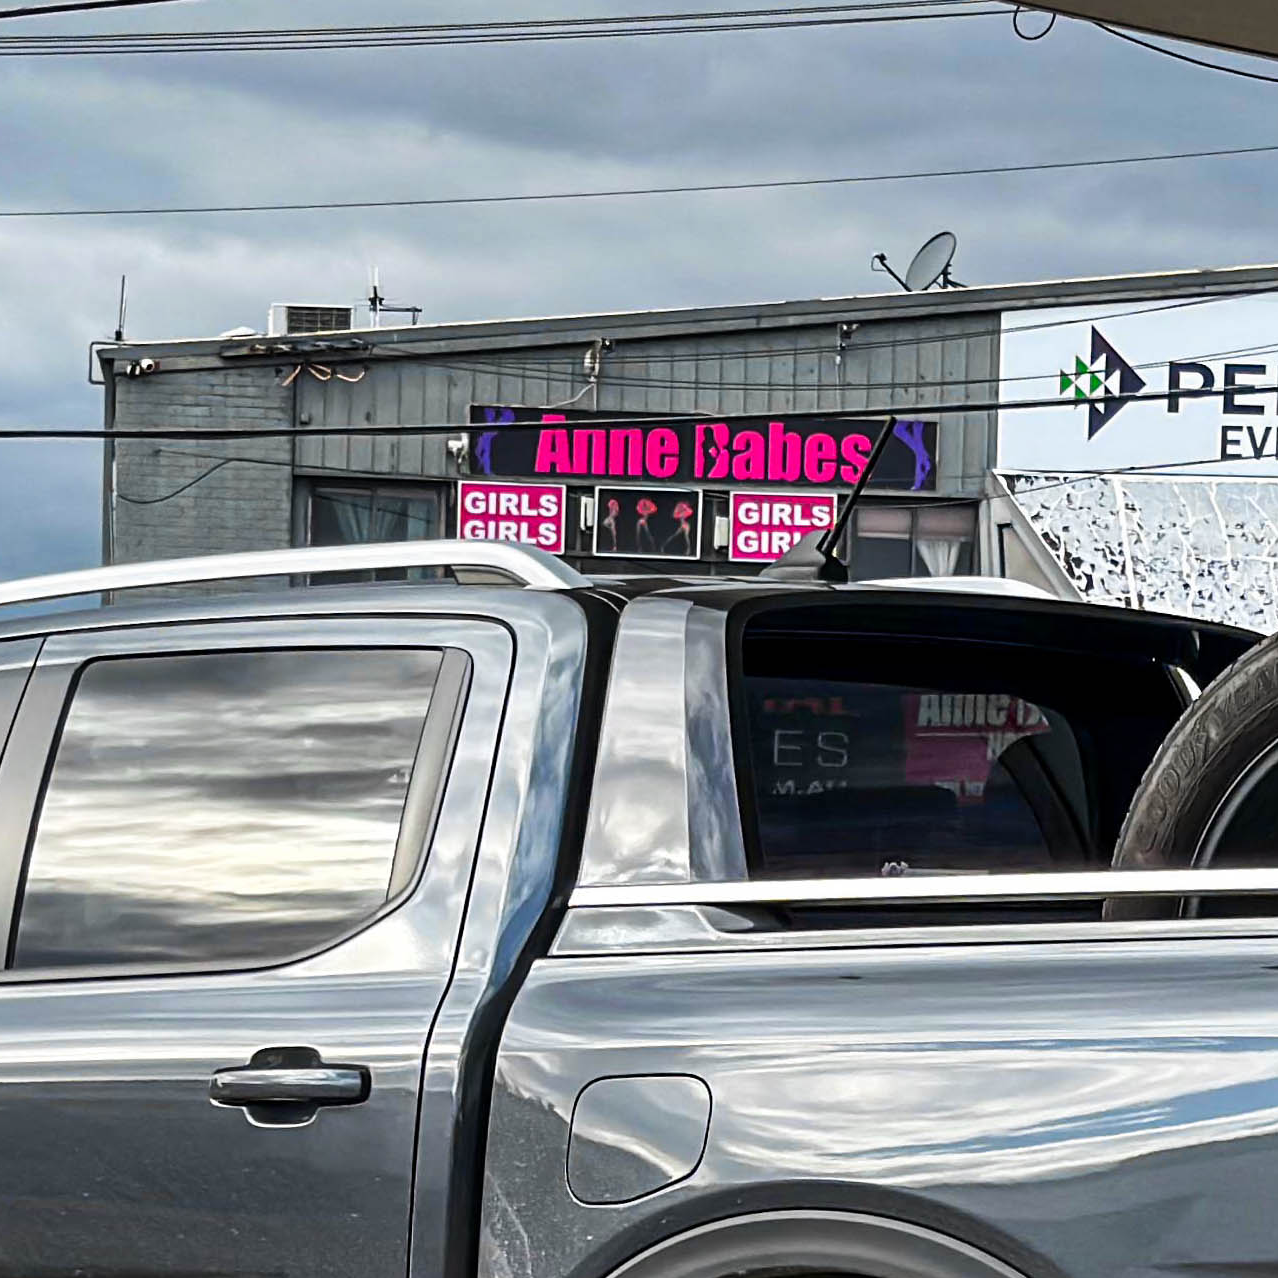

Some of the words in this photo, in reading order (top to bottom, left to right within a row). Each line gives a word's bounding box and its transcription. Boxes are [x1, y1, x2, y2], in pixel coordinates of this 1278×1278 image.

[534, 414, 680, 478] Anne
[694, 421, 873, 485] Babes
[464, 491, 559, 517] GIRLS
[737, 502, 832, 527] GIRLS
[463, 519, 558, 546] GIRLS
[736, 530, 802, 554] GIR
